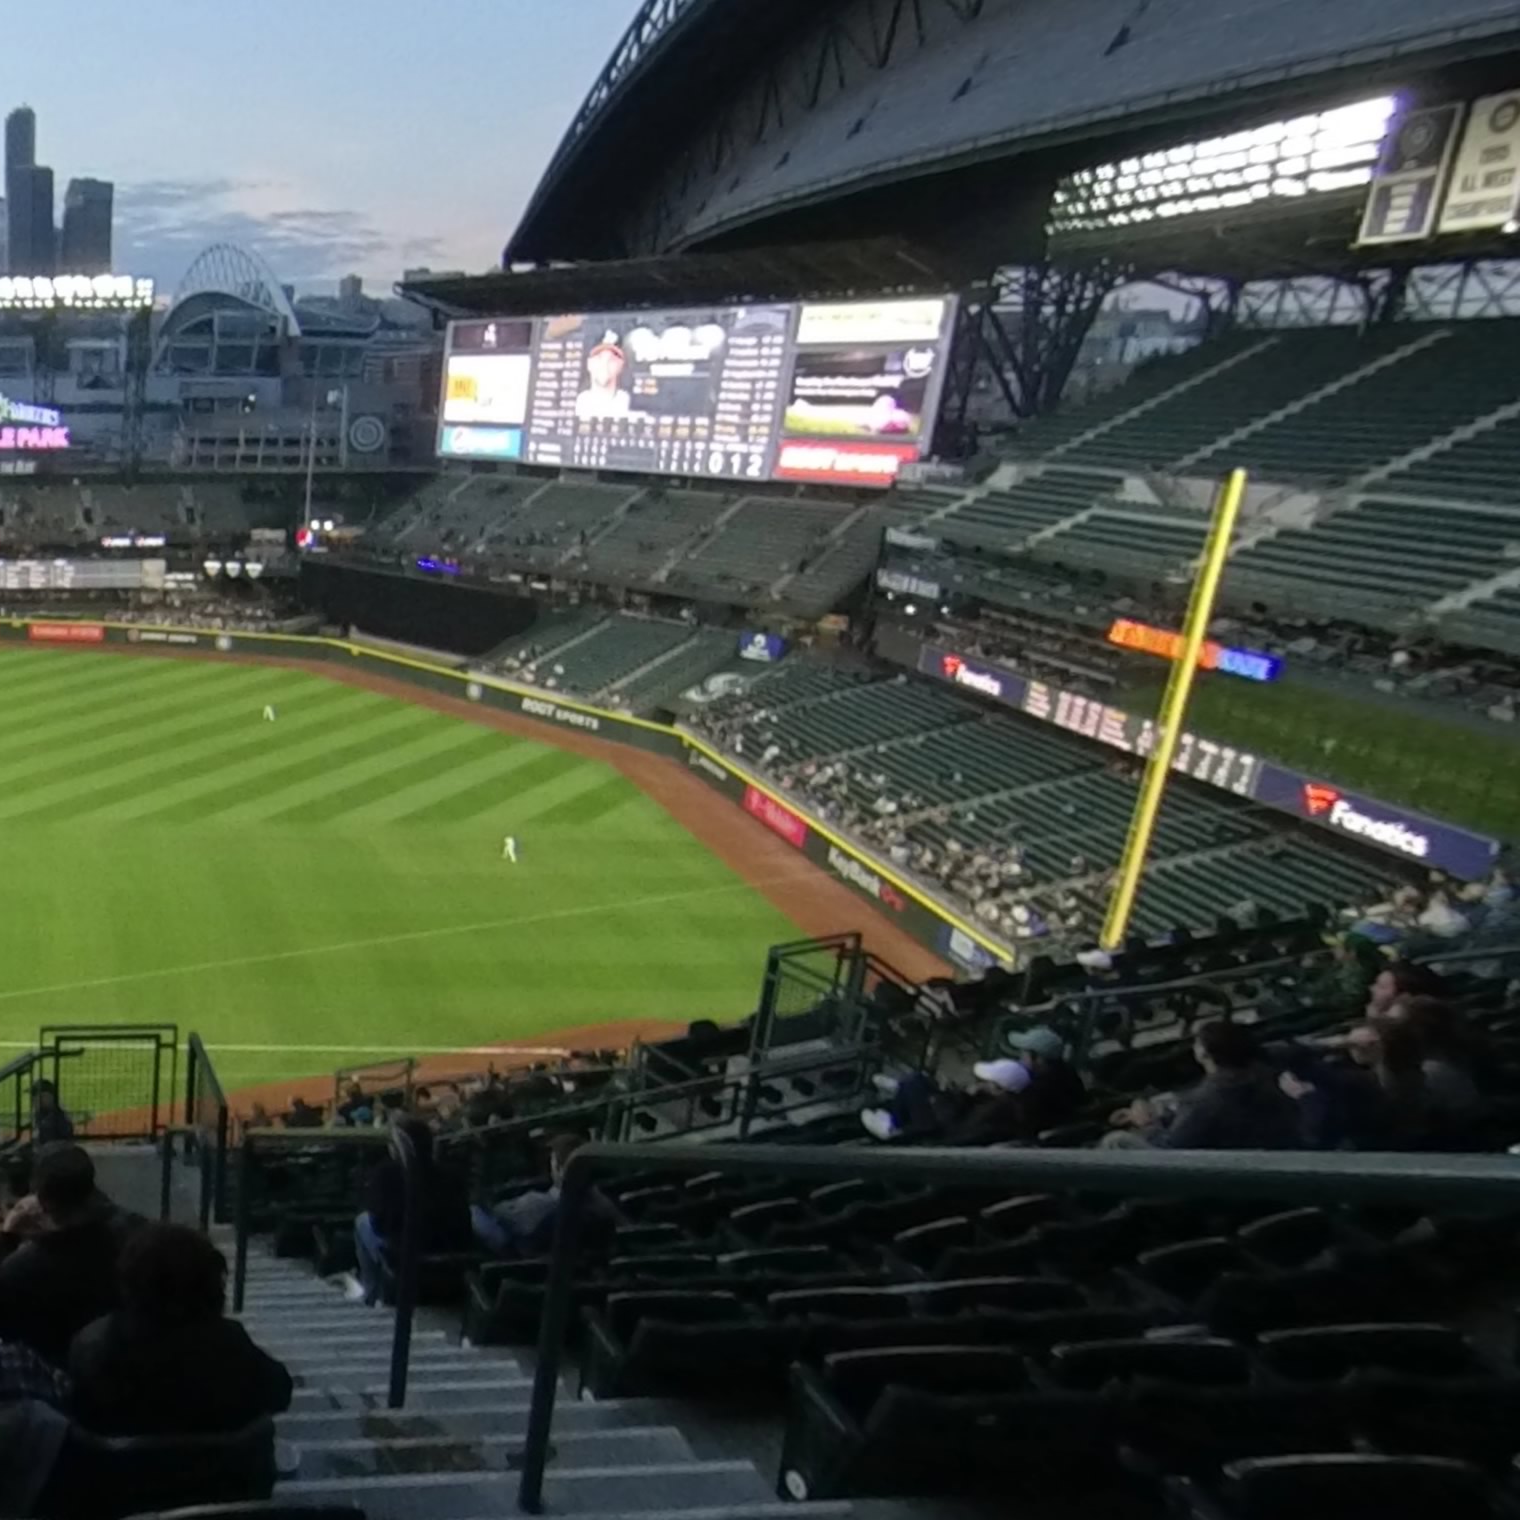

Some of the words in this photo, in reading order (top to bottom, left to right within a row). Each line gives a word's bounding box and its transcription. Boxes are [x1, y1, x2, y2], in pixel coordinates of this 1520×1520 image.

[17, 427, 70, 448] PARK
[730, 453, 741, 475] 1
[746, 454, 763, 477] 2
[521, 697, 556, 717] ROOT
[556, 709, 599, 731] SPORTS
[1330, 799, 1429, 857] Fanatics
